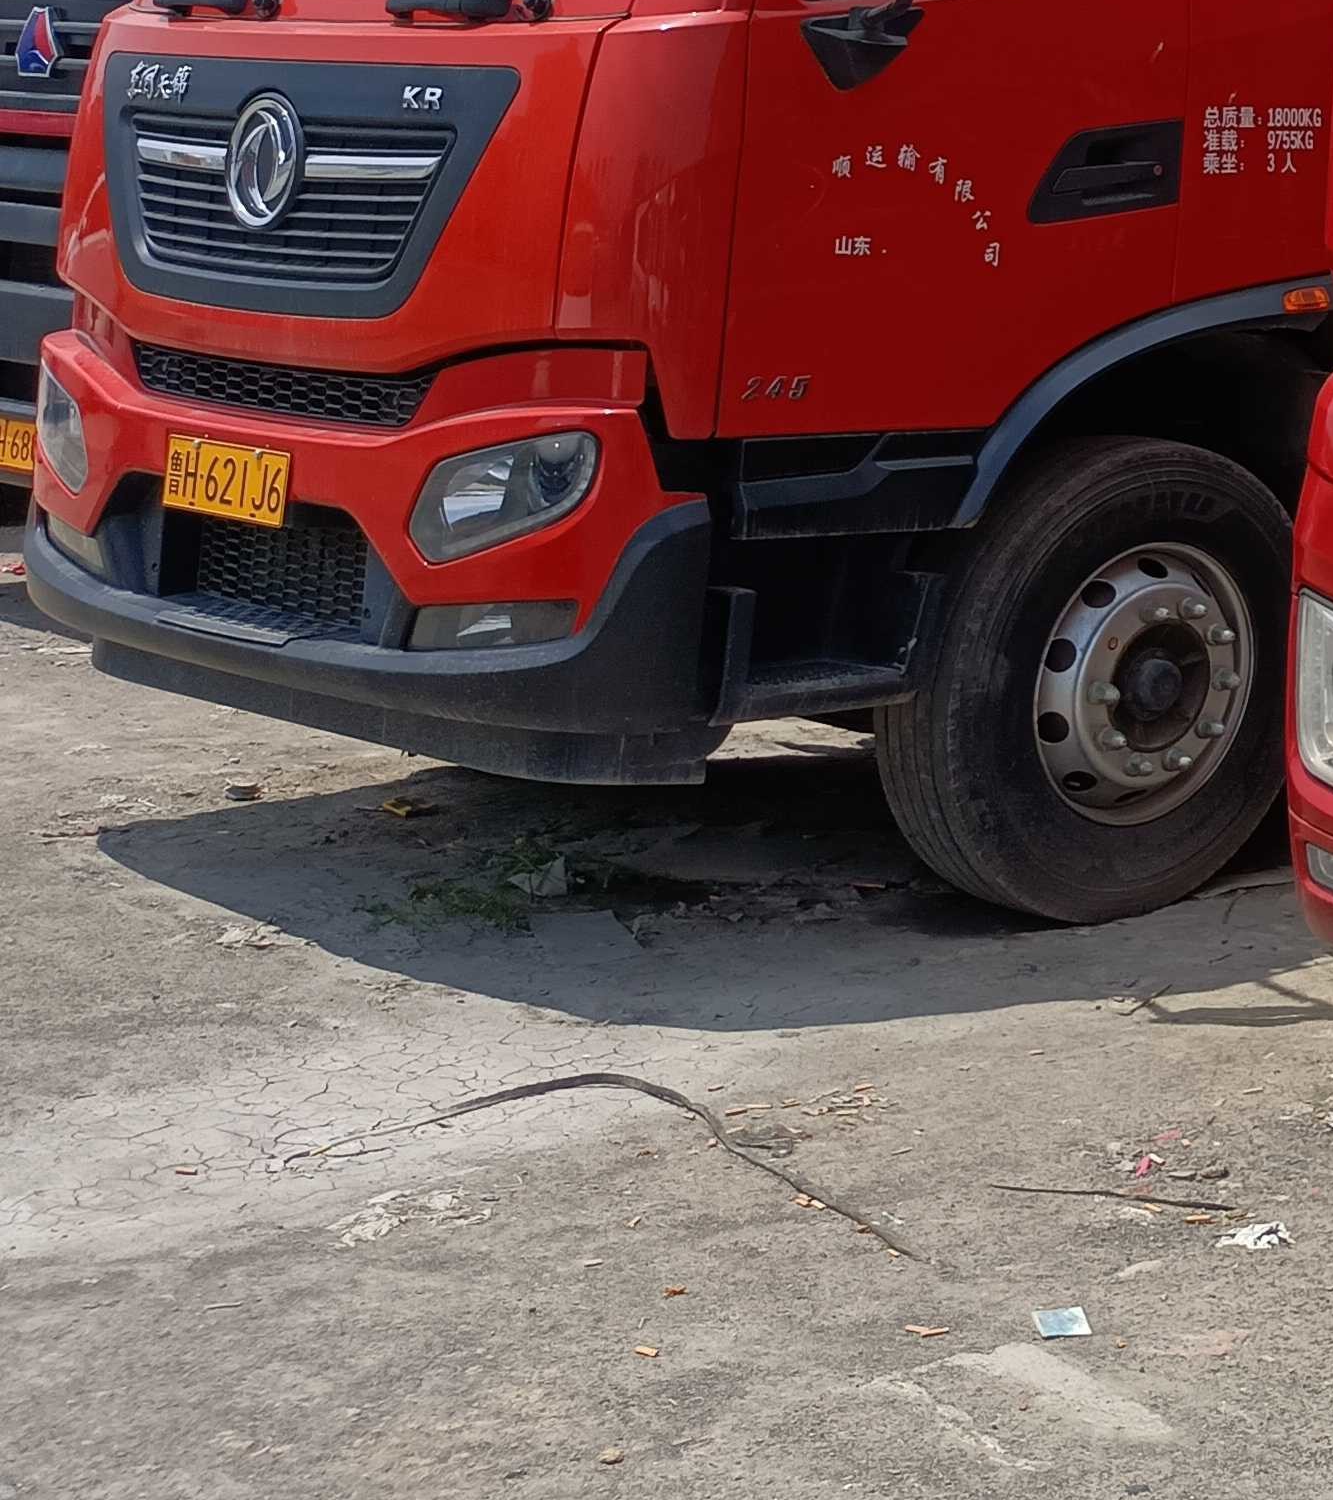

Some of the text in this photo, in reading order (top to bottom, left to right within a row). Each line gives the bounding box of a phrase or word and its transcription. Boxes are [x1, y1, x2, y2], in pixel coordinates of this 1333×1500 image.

[402, 85, 443, 111] KR
[1266, 130, 1315, 150] 9755KG
[834, 235, 872, 256] 山东
[741, 373, 812, 400] 245
